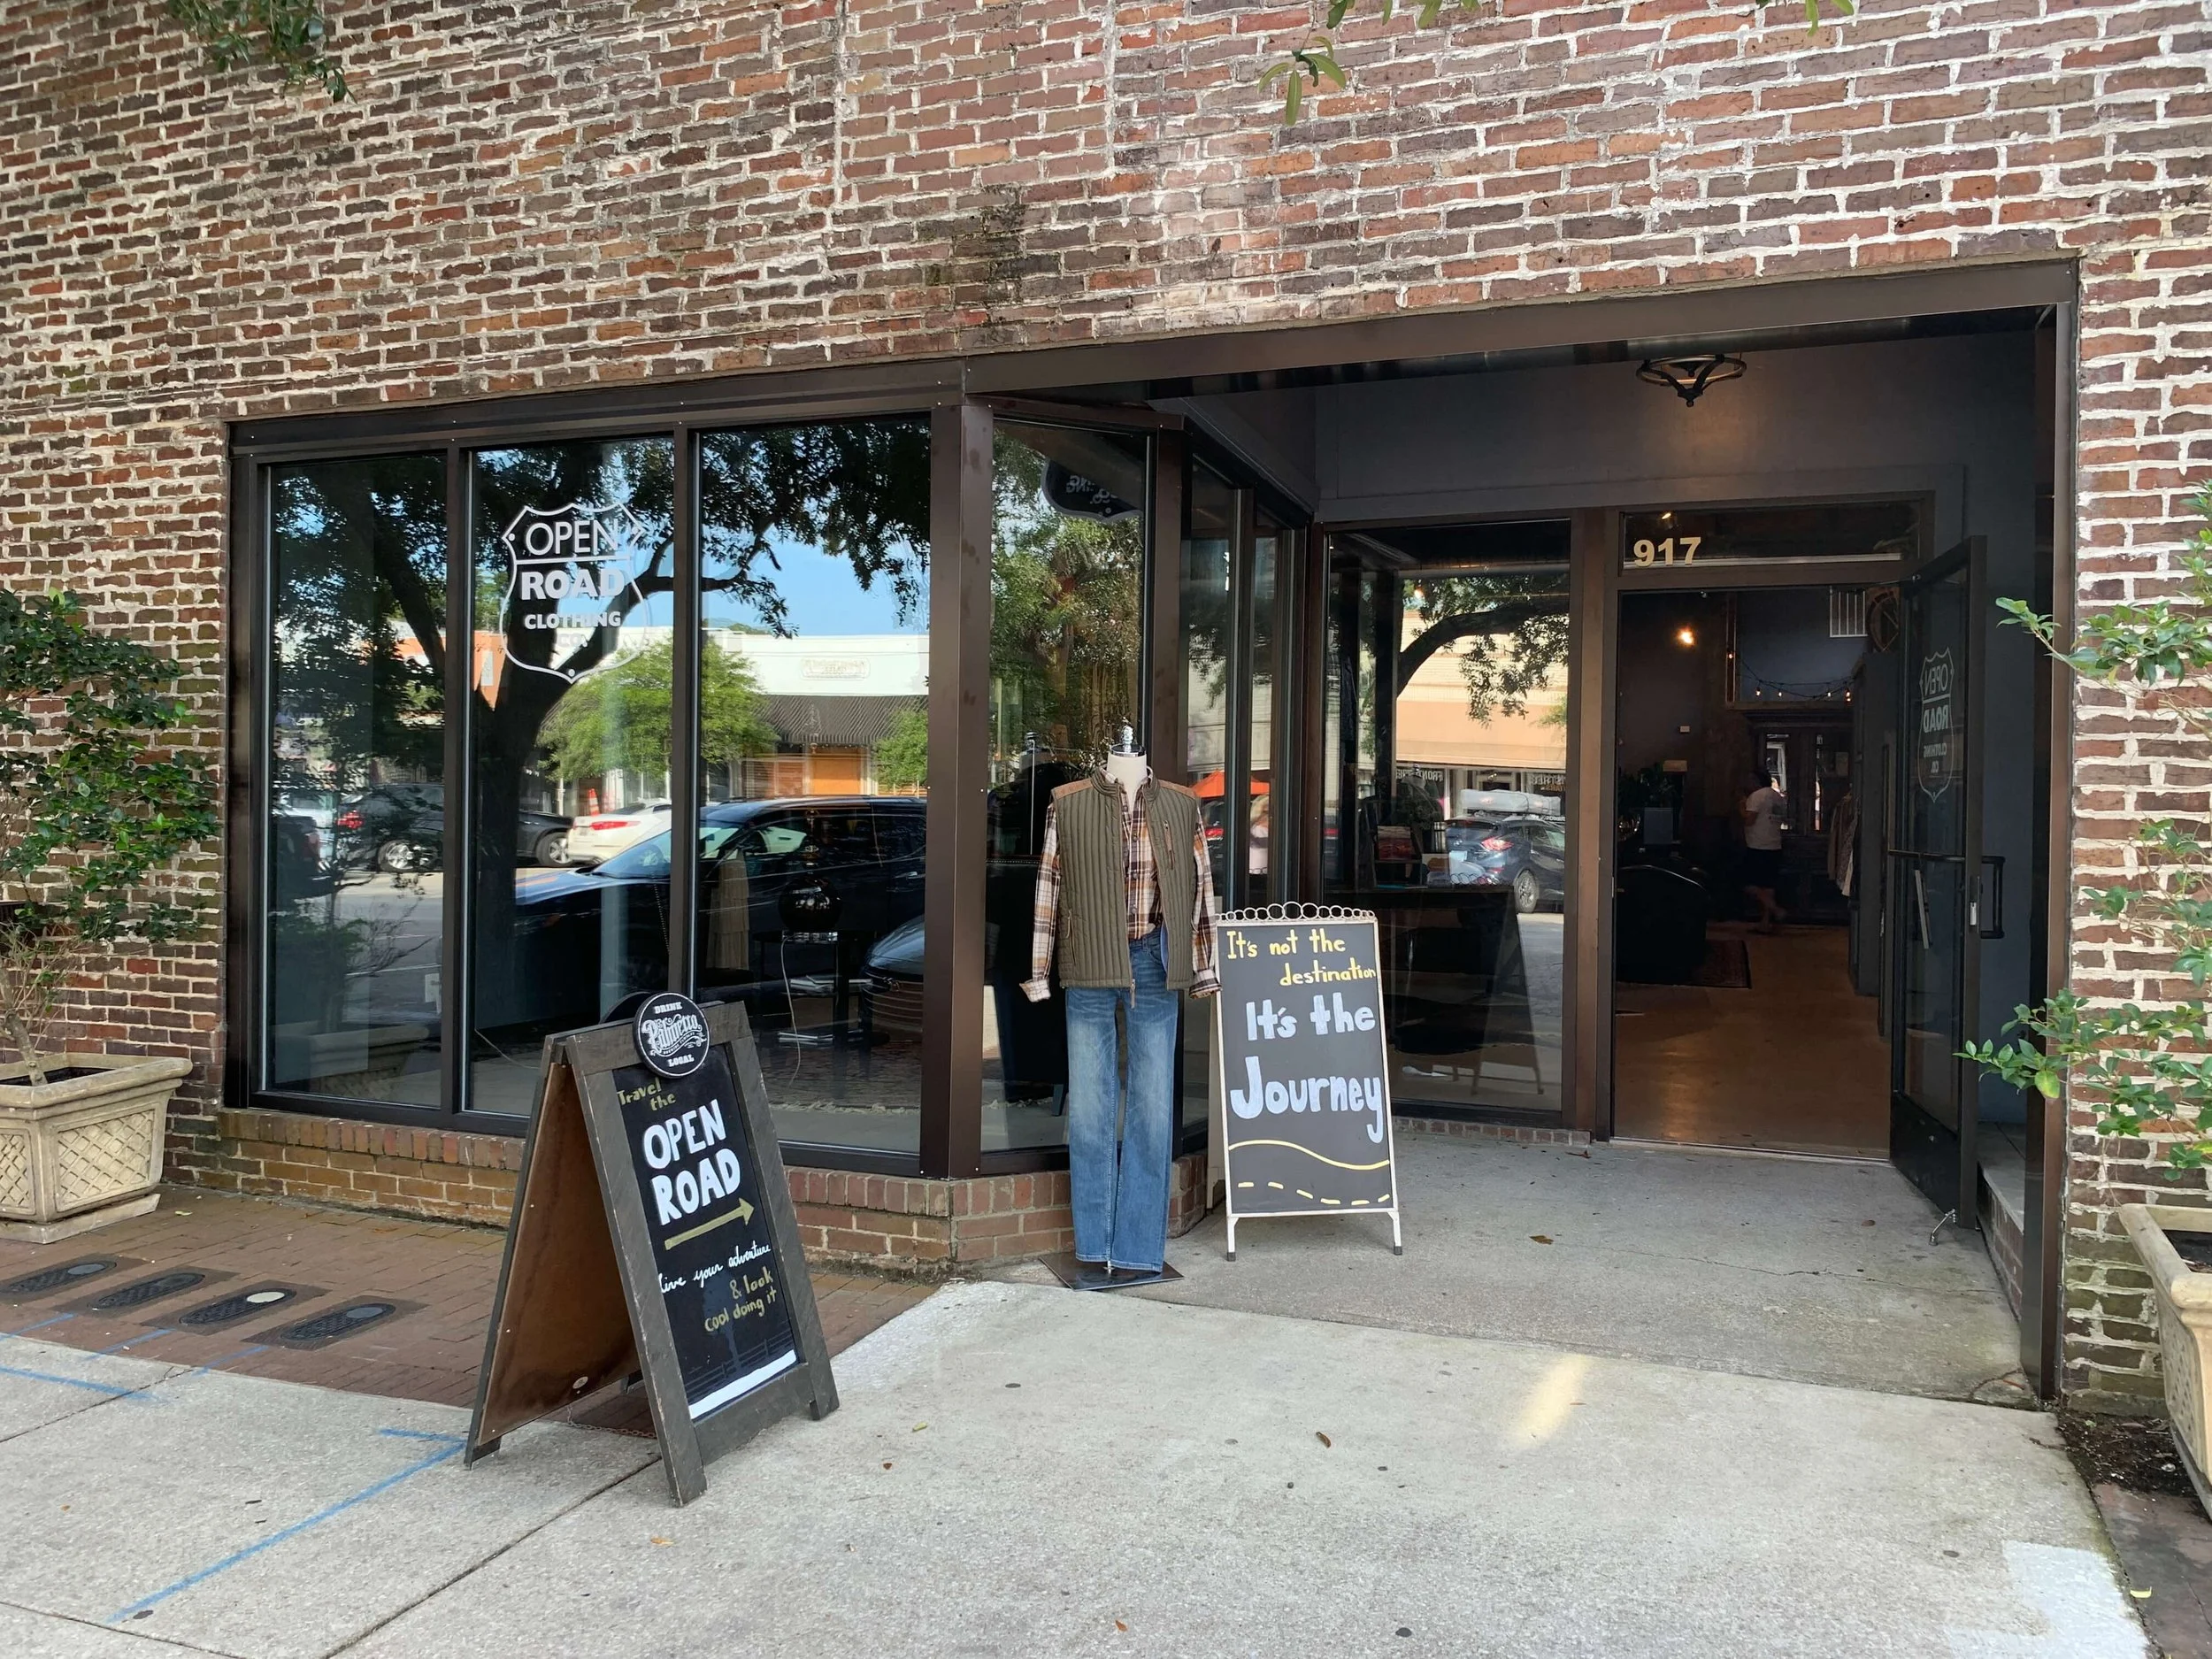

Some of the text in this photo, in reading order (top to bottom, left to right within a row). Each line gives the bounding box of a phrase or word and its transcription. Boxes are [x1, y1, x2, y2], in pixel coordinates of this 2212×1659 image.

[526, 518, 619, 556] OPEN
[1633, 536, 1701, 567] 917
[520, 568, 625, 601] ROAD
[524, 611, 621, 630] CLOTHING
[1226, 928, 1346, 959] It's not the
[1279, 957, 1376, 986] destination
[654, 1002, 683, 1014] DRINK
[1246, 992, 1376, 1041] It's the
[641, 1014, 702, 1051] Palmetto
[667, 1054, 695, 1067] LOCAL
[618, 1078, 661, 1105] Travel
[651, 1093, 676, 1111] the
[1230, 1056, 1383, 1143] Journey
[643, 1098, 726, 1170] OPEN
[651, 1148, 741, 1225] ROAD
[693, 1264, 724, 1287] your
[728, 1240, 772, 1268] adventure
[729, 1266, 773, 1299] & look
[704, 1286, 777, 1332] cool doing it
